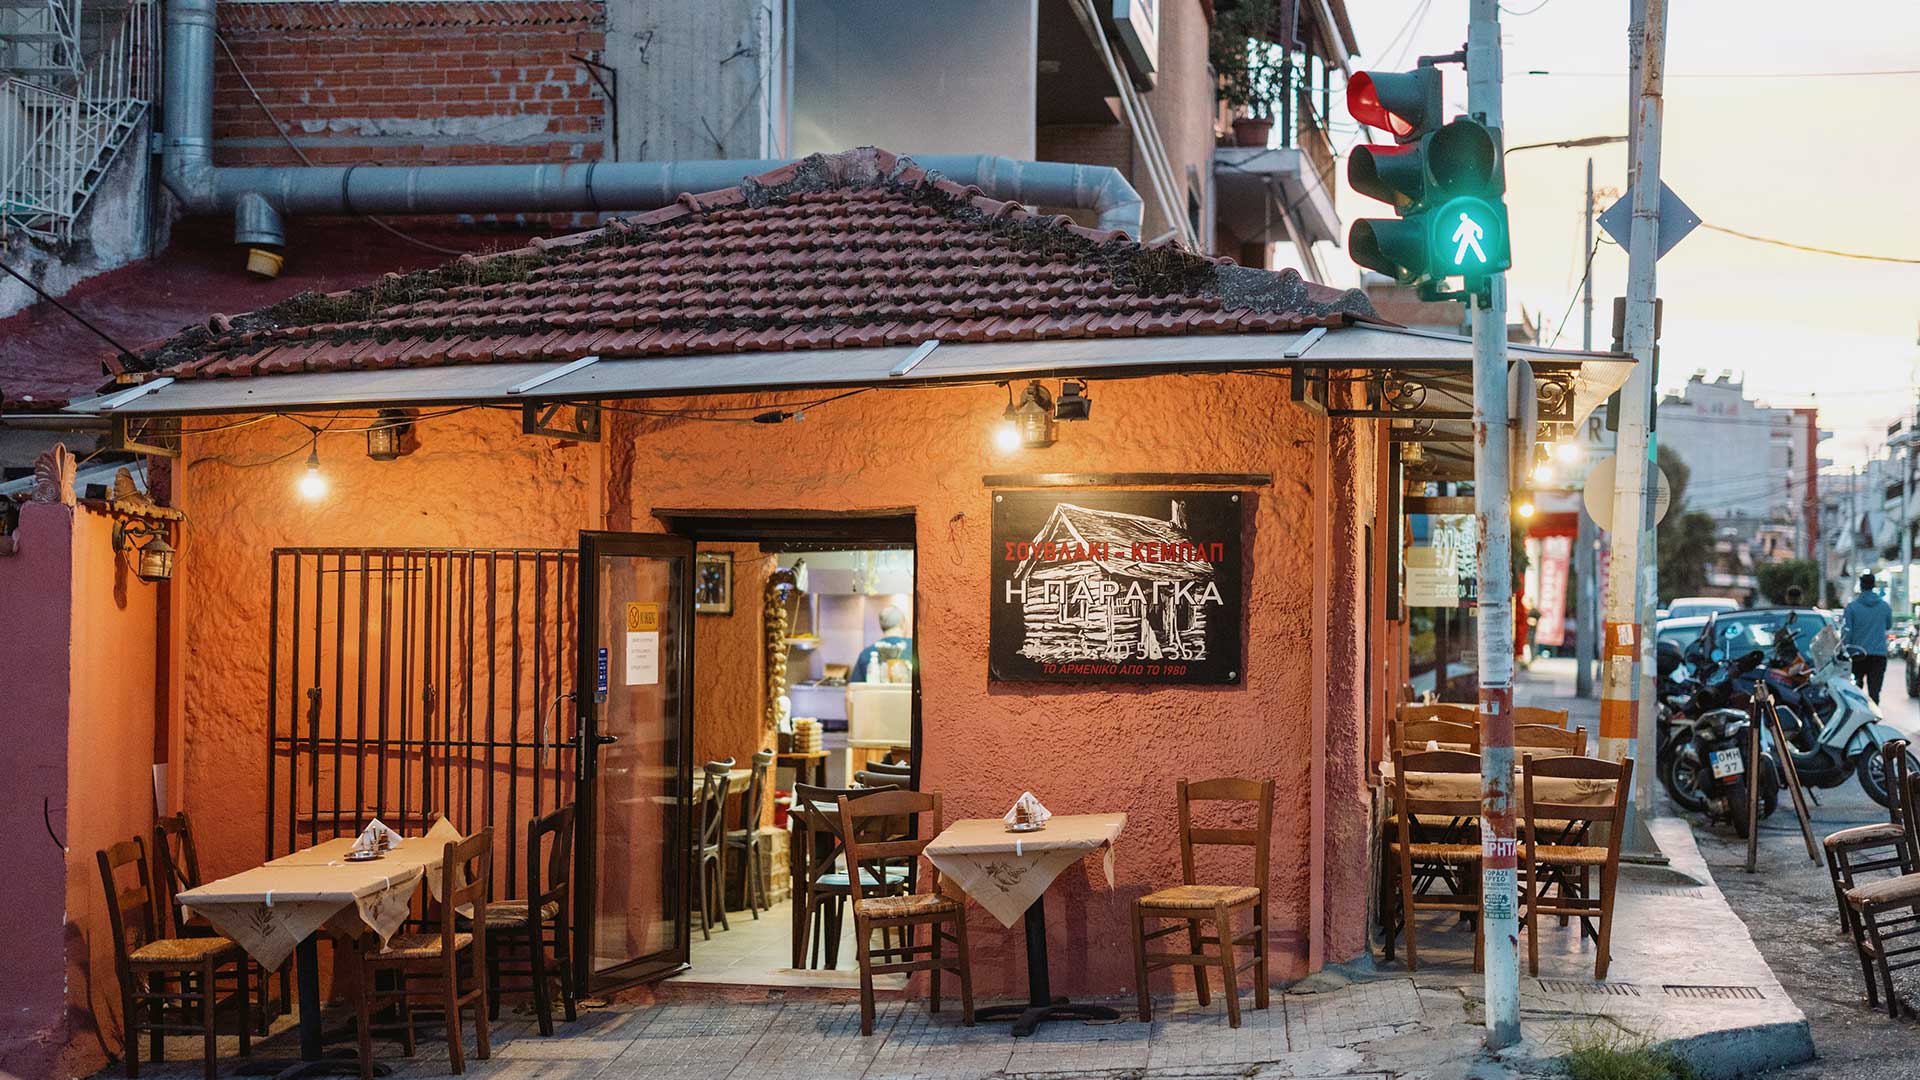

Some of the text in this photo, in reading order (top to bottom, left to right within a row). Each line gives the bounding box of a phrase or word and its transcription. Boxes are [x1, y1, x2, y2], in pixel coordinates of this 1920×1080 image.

[1004, 542, 1109, 561] ΣΟΥΒΛΑΚΙ
[1131, 543, 1224, 562] ΚΕΜΠΑΠ
[1005, 580, 1224, 605] Η ΠΑΡΑΓΚΑ
[1168, 643, 1206, 660] 352
[1043, 663, 1187, 676] ΤΟ ΑΡΜΕΝΙΚΟ ΑΠΟ ΤΟ 1980
